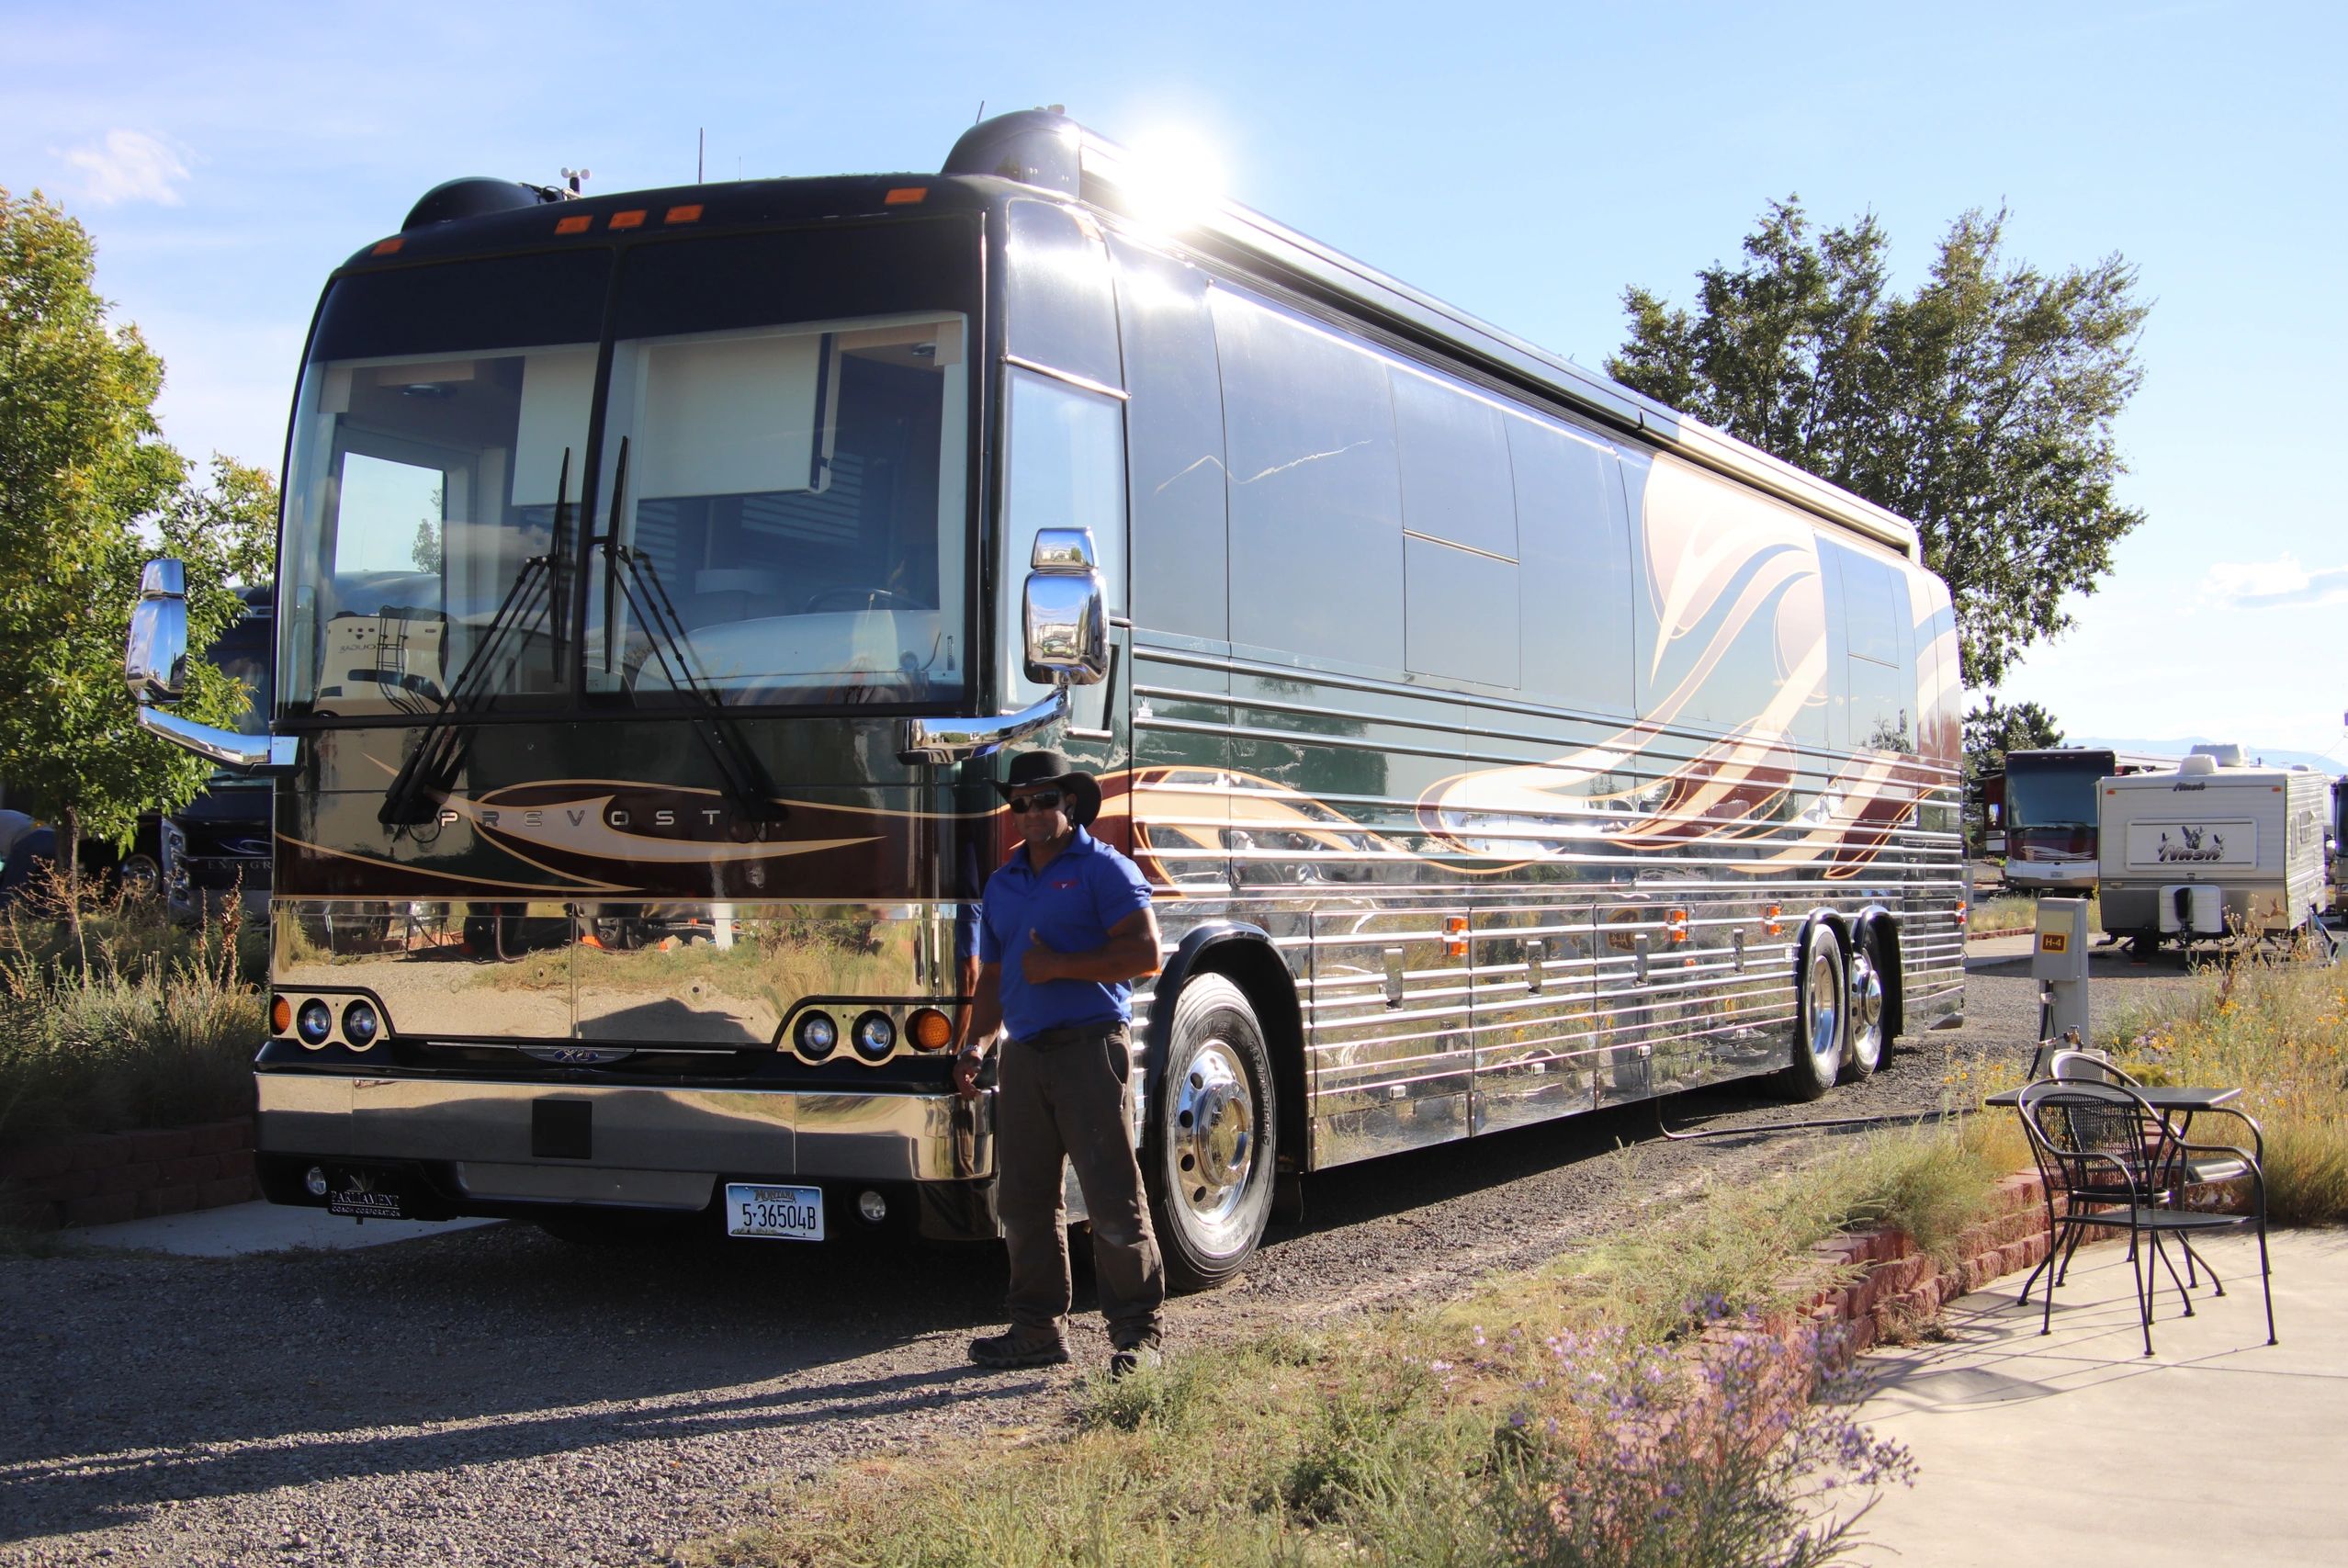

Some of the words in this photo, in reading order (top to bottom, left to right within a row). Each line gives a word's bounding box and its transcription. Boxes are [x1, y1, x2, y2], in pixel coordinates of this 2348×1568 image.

[441, 809, 721, 827] PREVOST
[2159, 844, 2222, 863] Nash
[2045, 938, 2061, 947] H-4
[331, 1190, 400, 1207] PARLIAMENT
[753, 1190, 796, 1202] MONTANA
